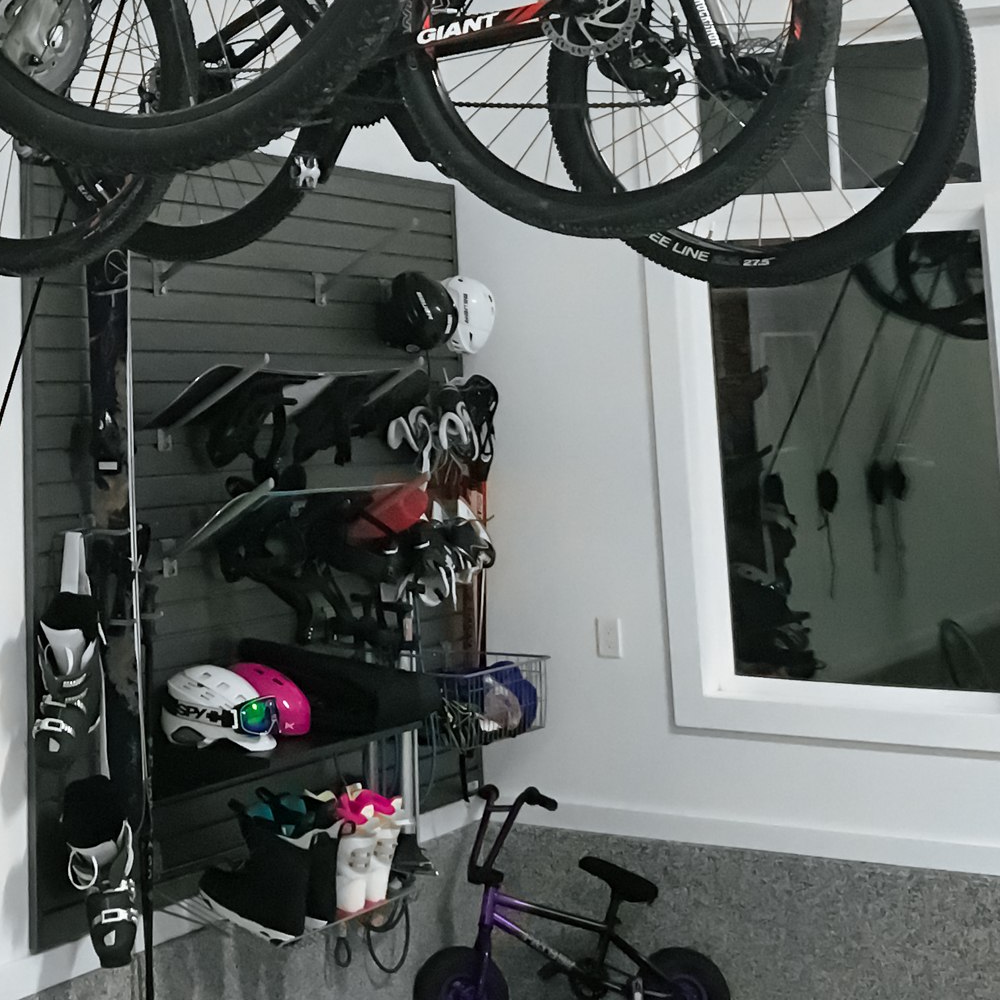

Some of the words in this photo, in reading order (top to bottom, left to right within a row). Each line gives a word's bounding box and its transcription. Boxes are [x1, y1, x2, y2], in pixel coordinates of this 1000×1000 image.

[416, 11, 500, 45] GIANT
[648, 231, 672, 249] EE
[671, 241, 711, 262] LINE
[177, 703, 207, 719] SPY
